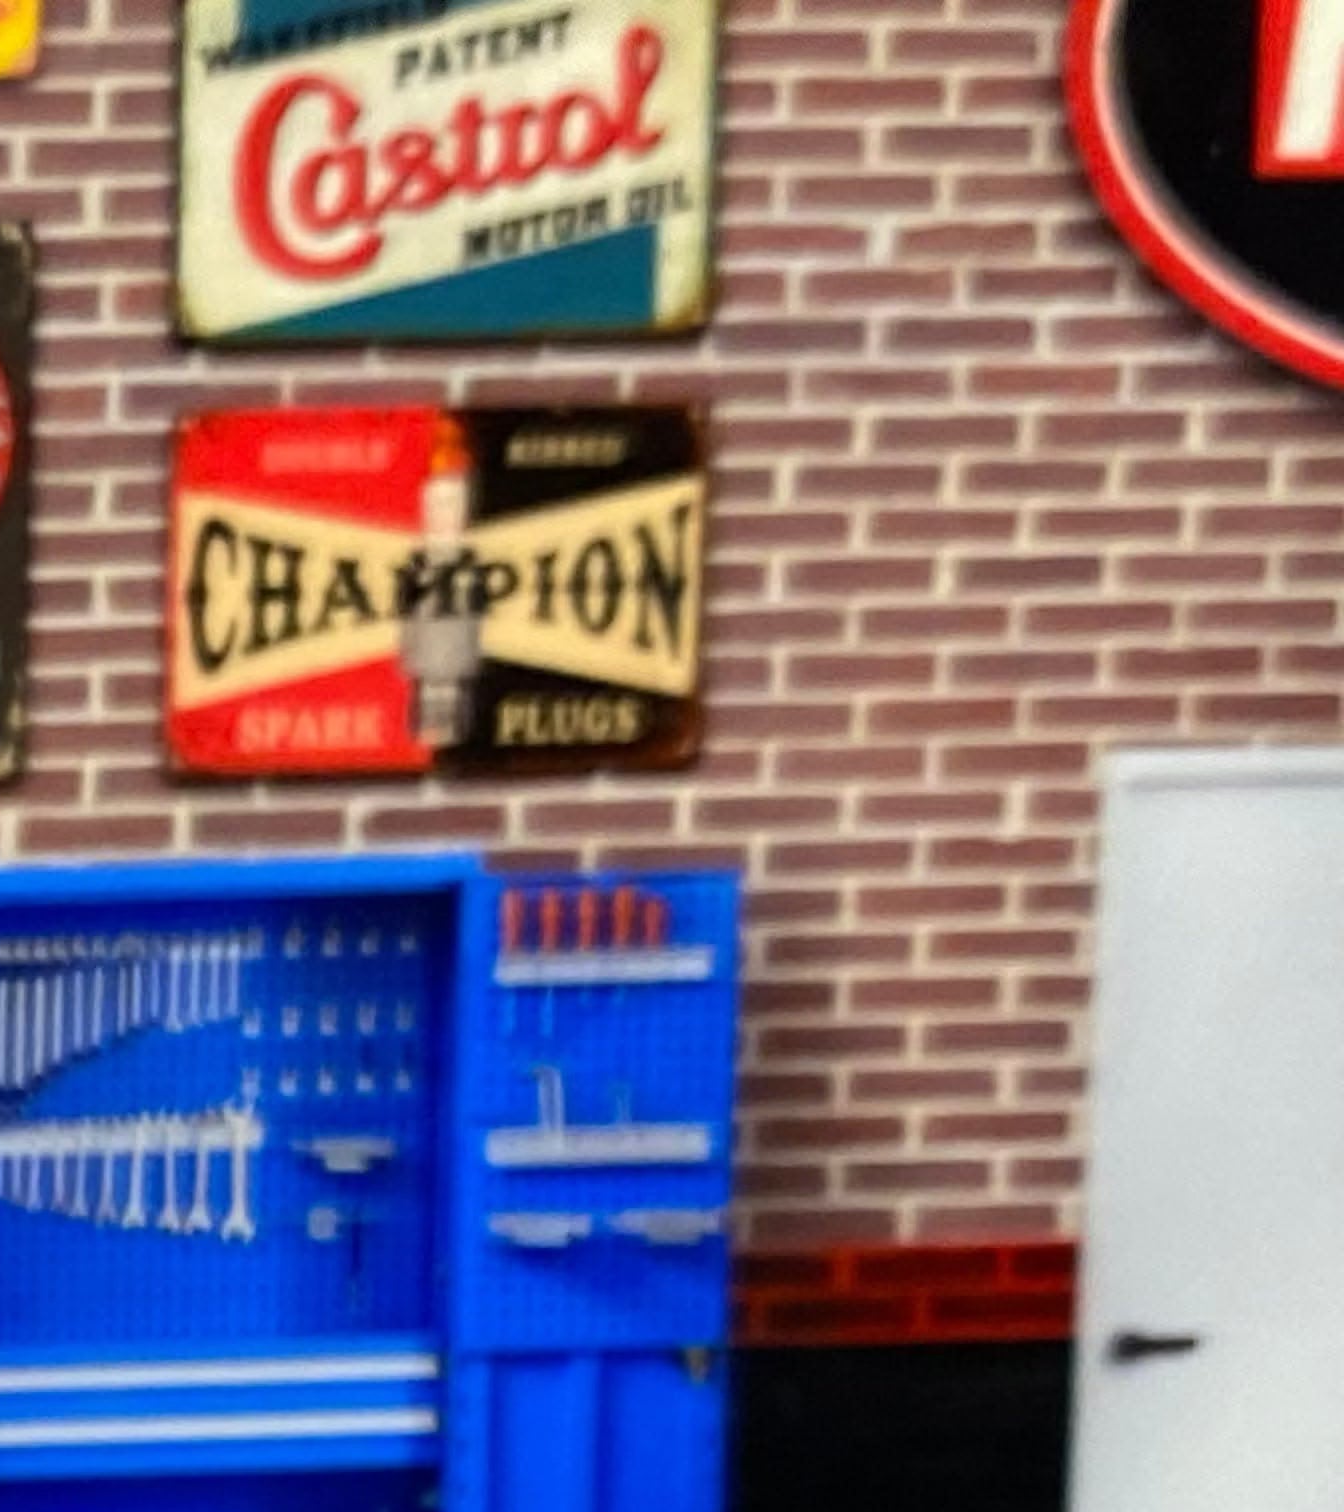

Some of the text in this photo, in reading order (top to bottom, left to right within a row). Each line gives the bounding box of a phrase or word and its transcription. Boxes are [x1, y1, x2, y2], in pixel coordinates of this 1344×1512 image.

[393, 13, 572, 88] PATENT
[232, 20, 667, 282] Castrol
[461, 177, 691, 264] MOTOR OIL
[186, 502, 692, 676] CHAMPION
[237, 697, 642, 752] SPARK PLUGS
